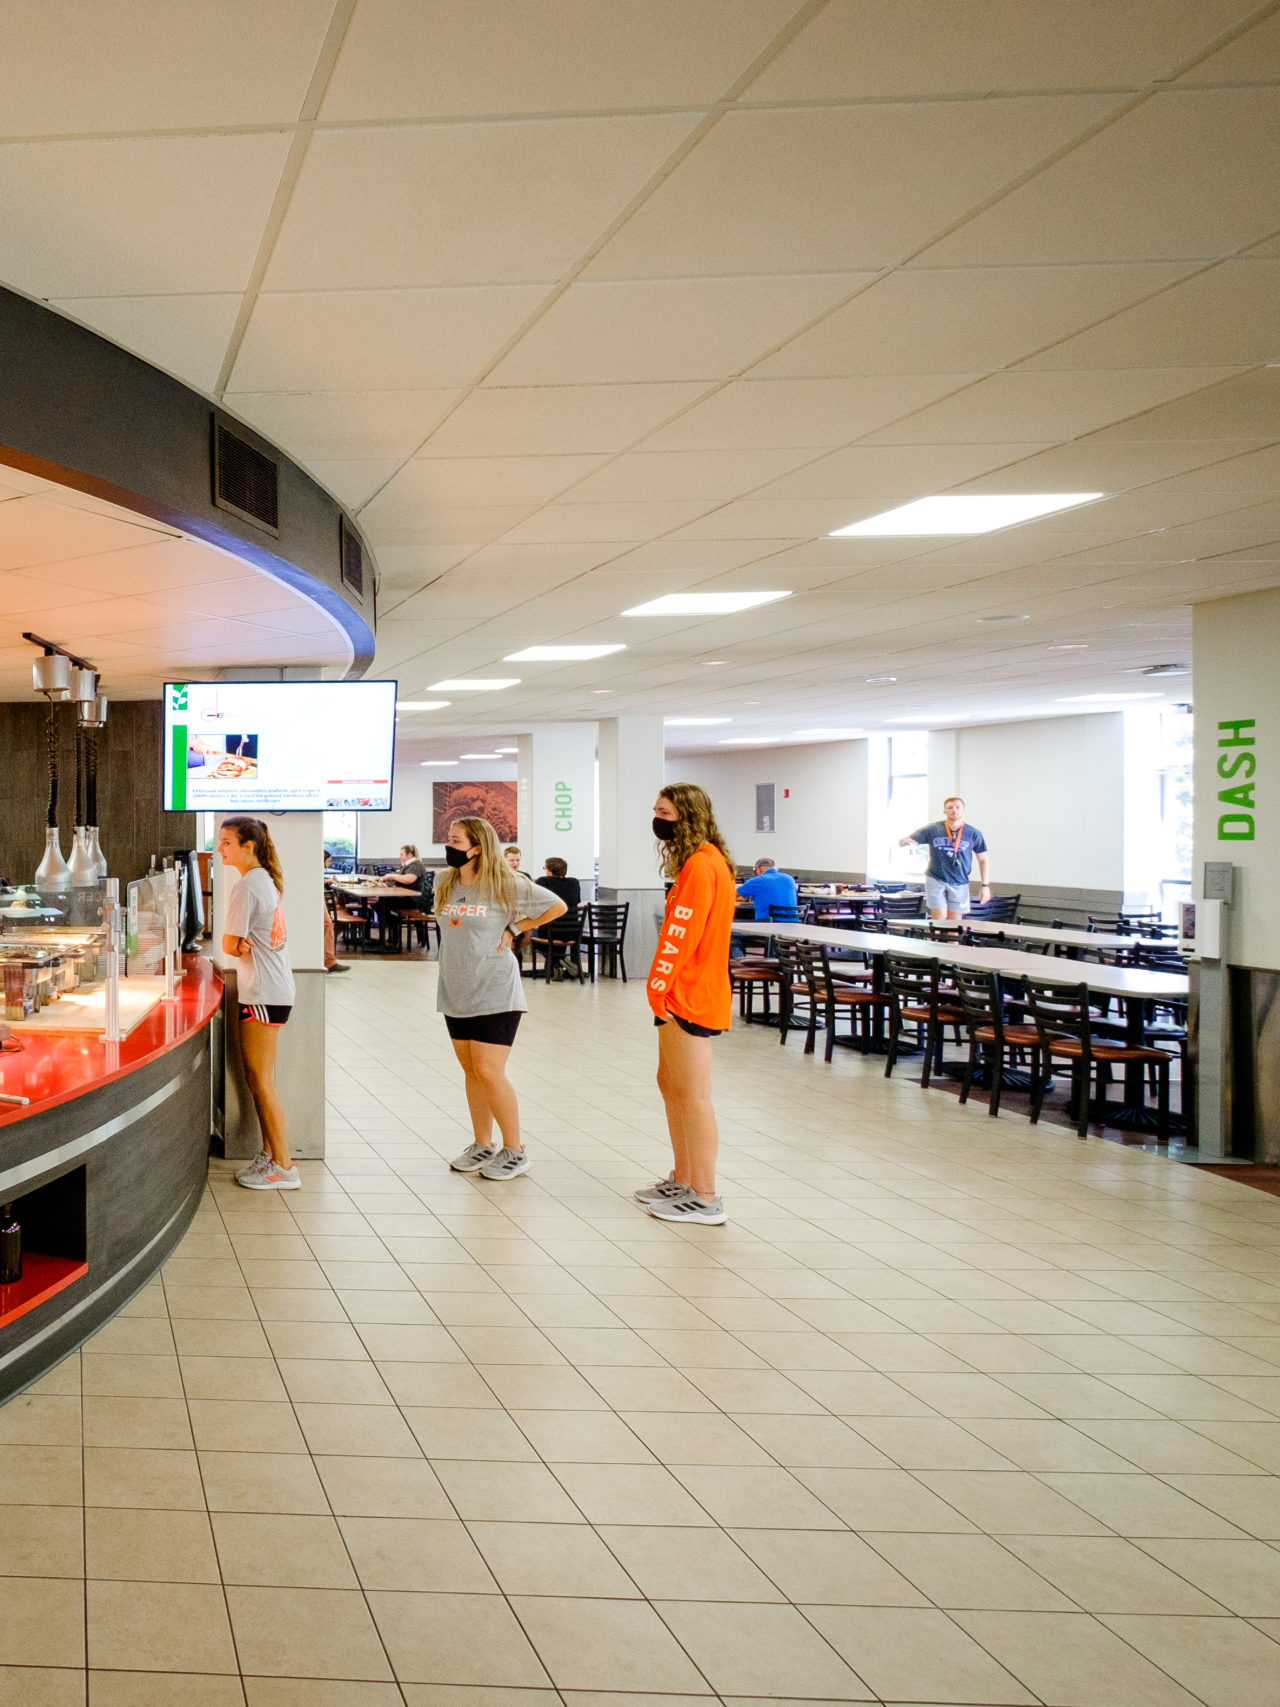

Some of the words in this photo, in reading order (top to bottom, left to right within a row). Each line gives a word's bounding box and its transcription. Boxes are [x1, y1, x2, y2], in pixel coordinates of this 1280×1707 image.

[554, 780, 573, 832] CHOP
[1217, 719, 1256, 841] DASH
[442, 904, 487, 917] ERCER
[650, 905, 693, 992] BEARS
